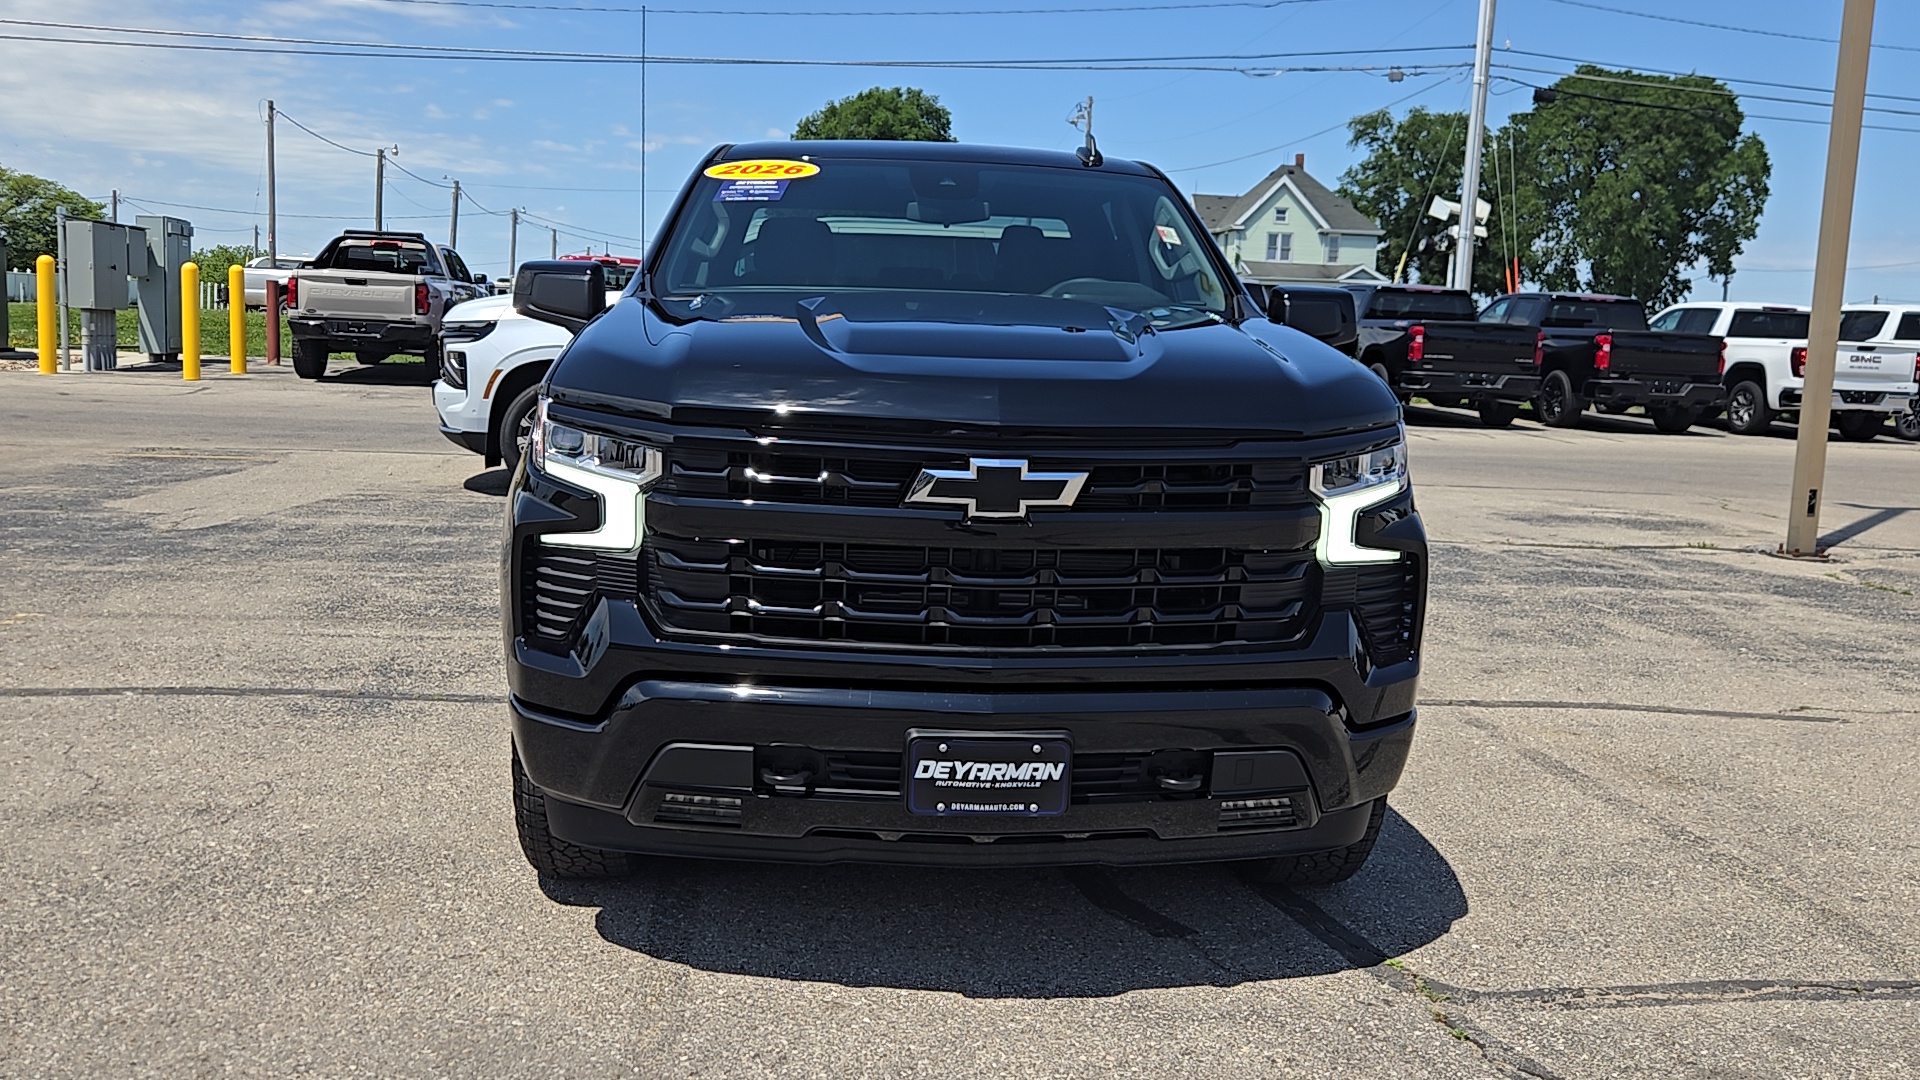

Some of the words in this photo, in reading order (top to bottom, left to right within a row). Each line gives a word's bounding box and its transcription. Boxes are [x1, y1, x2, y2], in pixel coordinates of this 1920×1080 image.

[715, 165, 806, 175] 2026
[310, 287, 403, 299] CHEVROLET
[1850, 355, 1881, 363] GMC
[914, 760, 1065, 780] DEYARMAN
[951, 802, 1025, 811] DEYARMANAUTO.COM
